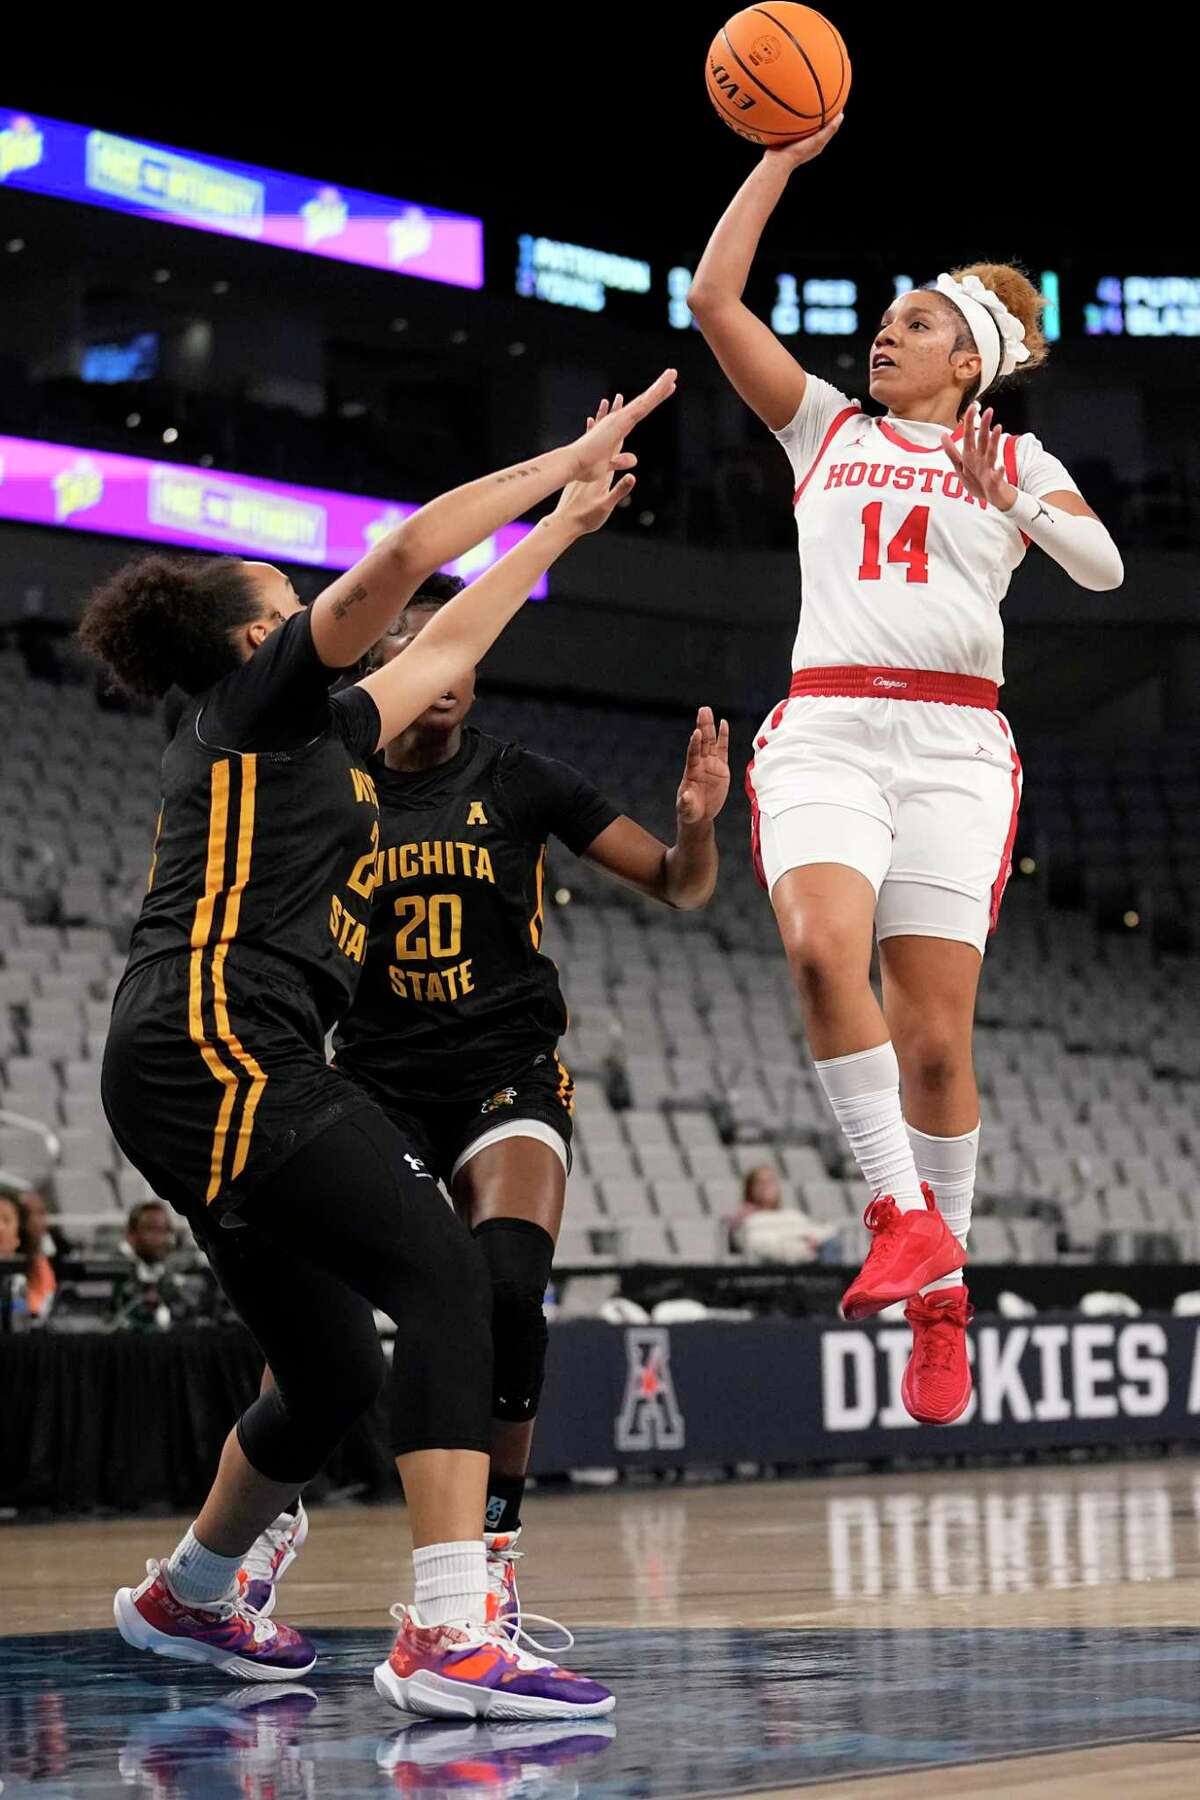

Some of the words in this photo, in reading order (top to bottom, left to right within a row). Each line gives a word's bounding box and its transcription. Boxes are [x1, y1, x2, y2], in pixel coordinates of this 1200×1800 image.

[858, 501, 930, 583] 14
[466, 801, 488, 825] A
[394, 894, 462, 960] 20
[388, 959, 476, 1003] STATE
[821, 1323, 1169, 1432] DIKIES
